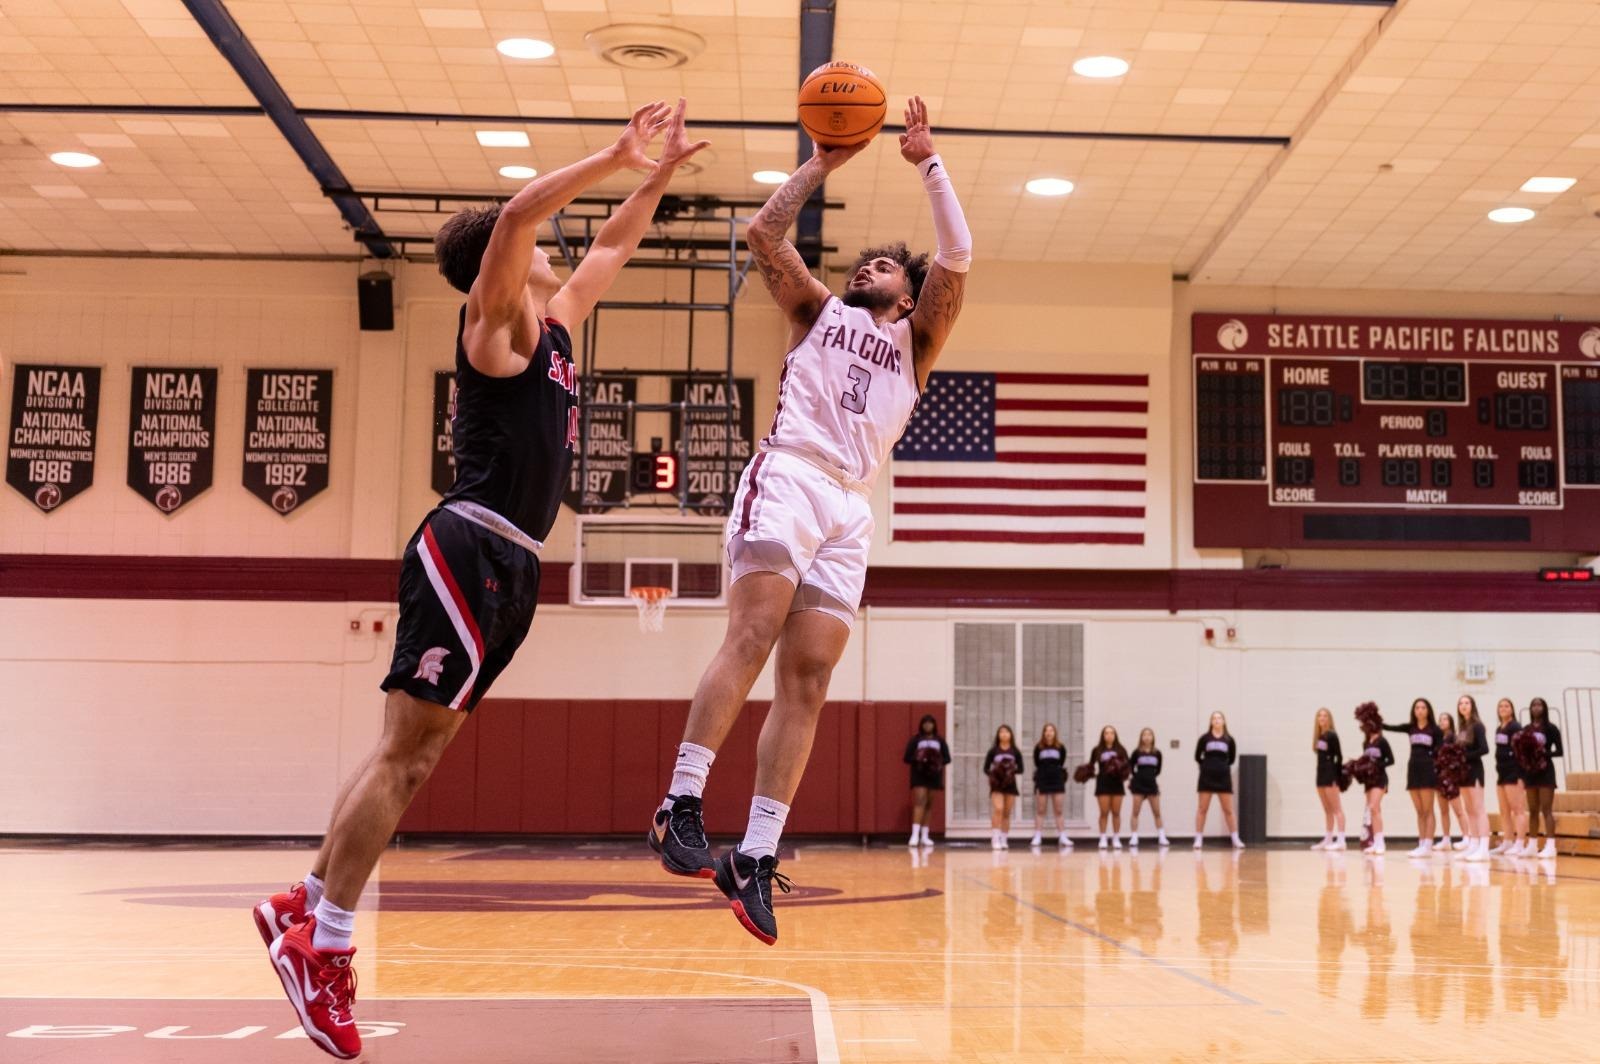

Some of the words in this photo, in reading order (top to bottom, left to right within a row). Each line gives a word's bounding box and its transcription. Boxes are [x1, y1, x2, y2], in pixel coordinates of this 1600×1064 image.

[1268, 324, 1360, 348] SEATTLE
[1369, 326, 1454, 351] PACIFIC
[1463, 328, 1560, 353] FALCONS
[28, 370, 85, 397] NCAA
[1283, 367, 1330, 385] HOME
[1497, 371, 1547, 389] GUEST
[145, 373, 203, 399] NCAA
[262, 374, 319, 400] USGF
[841, 364, 871, 414] 3
[26, 396, 72, 409] DIVISION
[76, 398, 84, 410] II
[144, 398, 190, 411] DIVISION
[194, 399, 202, 411] II
[257, 399, 319, 413] COLLEGIATE
[22, 411, 85, 430] NATIONAL
[141, 414, 203, 431] NATIONAL
[256, 415, 319, 433] NATIONAL
[1380, 415, 1424, 430] PERIOD
[14, 428, 92, 447] CHAMPIONS
[133, 430, 210, 448] CHAMPIONS
[249, 431, 326, 449] CHAMPIONS
[10, 448, 44, 460] WOMEN'S
[46, 449, 93, 462] GYMNASTICS
[144, 451, 166, 462] MEN'S
[168, 451, 197, 462] SOCCER
[245, 451, 279, 463] WOMEN'S
[281, 452, 328, 464] GYMNASTICS
[1278, 442, 1312, 457] FOULS
[1334, 443, 1366, 457] T.O.L.
[1378, 444, 1423, 458] PLAYER
[1426, 445, 1457, 459] FOUL
[1467, 445, 1499, 459] T.O.L.
[1520, 446, 1553, 460] FOULS
[28, 460, 72, 483] 1986
[148, 462, 191, 484] 1986
[265, 463, 307, 486] 1992
[655, 455, 676, 490] 3
[1275, 488, 1316, 502] SCORE
[1406, 489, 1447, 503] MATCH
[1518, 491, 1557, 505] SCORE
